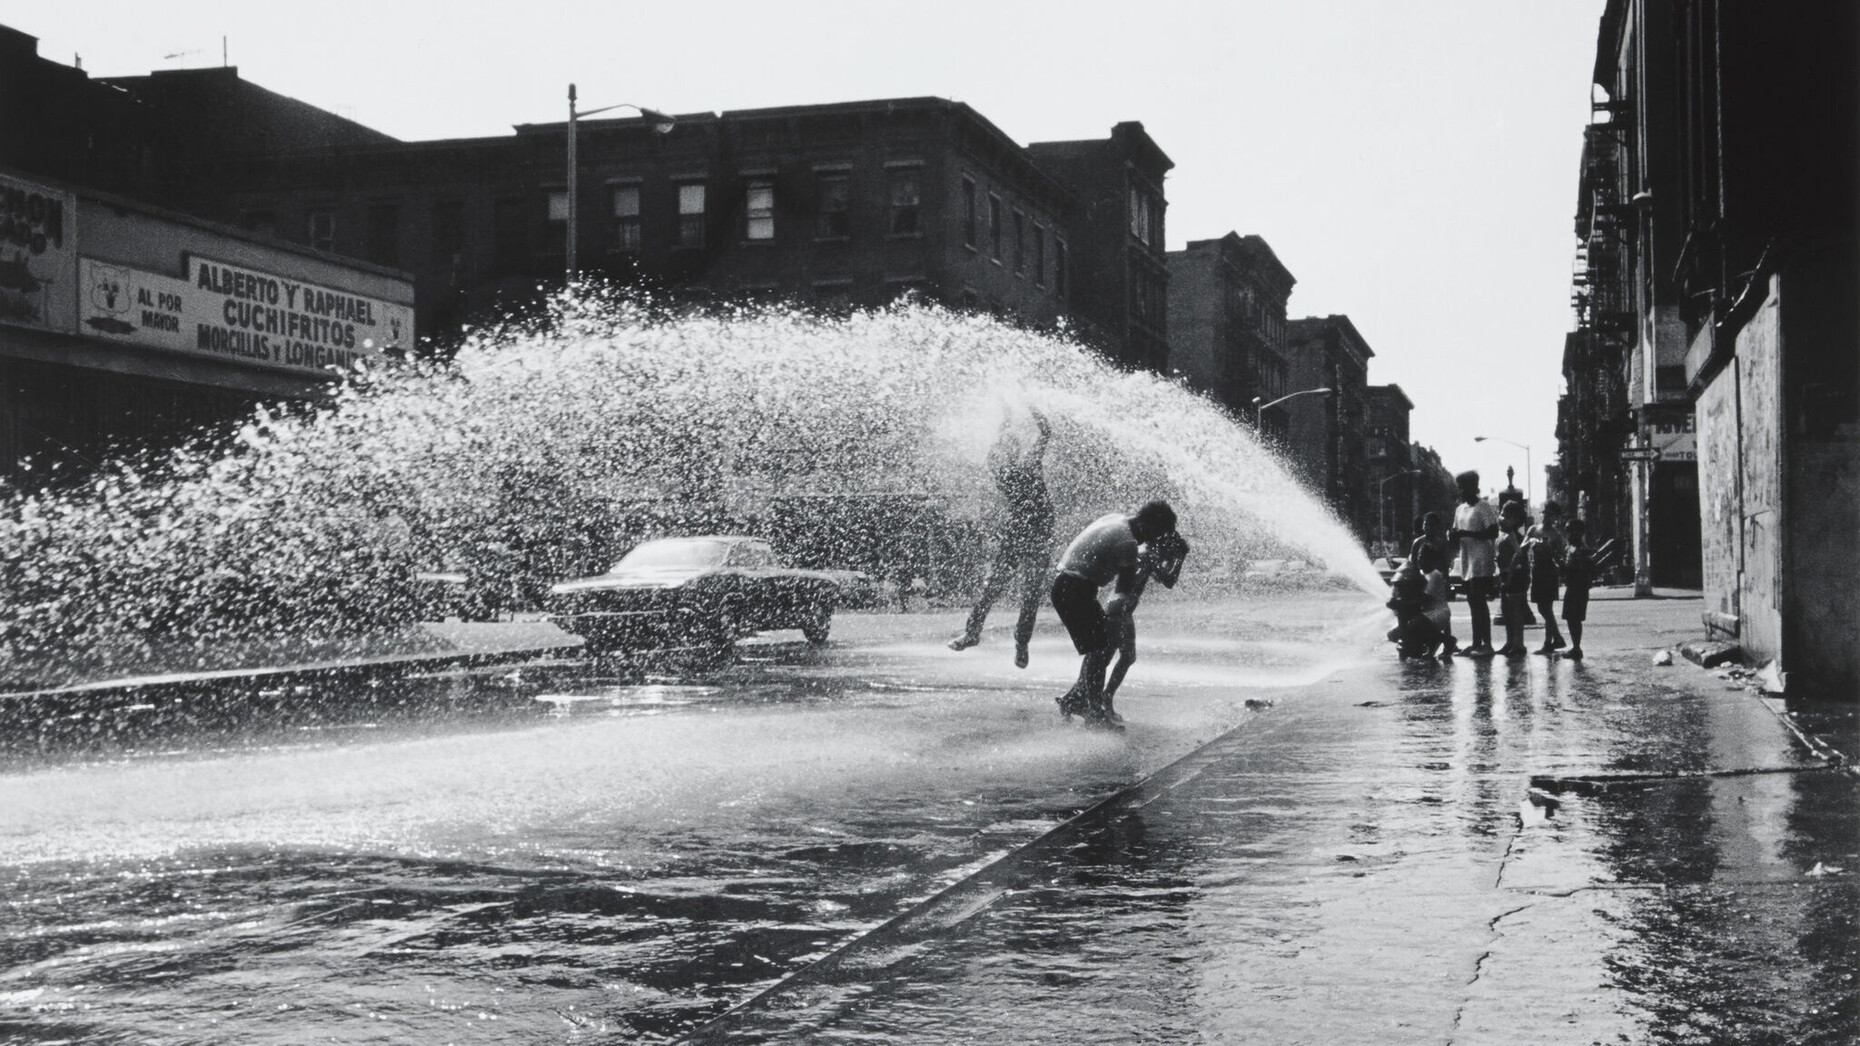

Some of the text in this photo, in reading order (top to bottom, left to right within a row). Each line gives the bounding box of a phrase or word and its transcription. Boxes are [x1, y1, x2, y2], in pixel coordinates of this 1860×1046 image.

[138, 286, 182, 313] AL POR
[197, 263, 376, 327] ALBERTO Y RAPHAEL
[141, 310, 179, 333] MAYOR
[223, 298, 355, 349] CUCHIFRITOS
[197, 323, 270, 360] MORCILLAS
